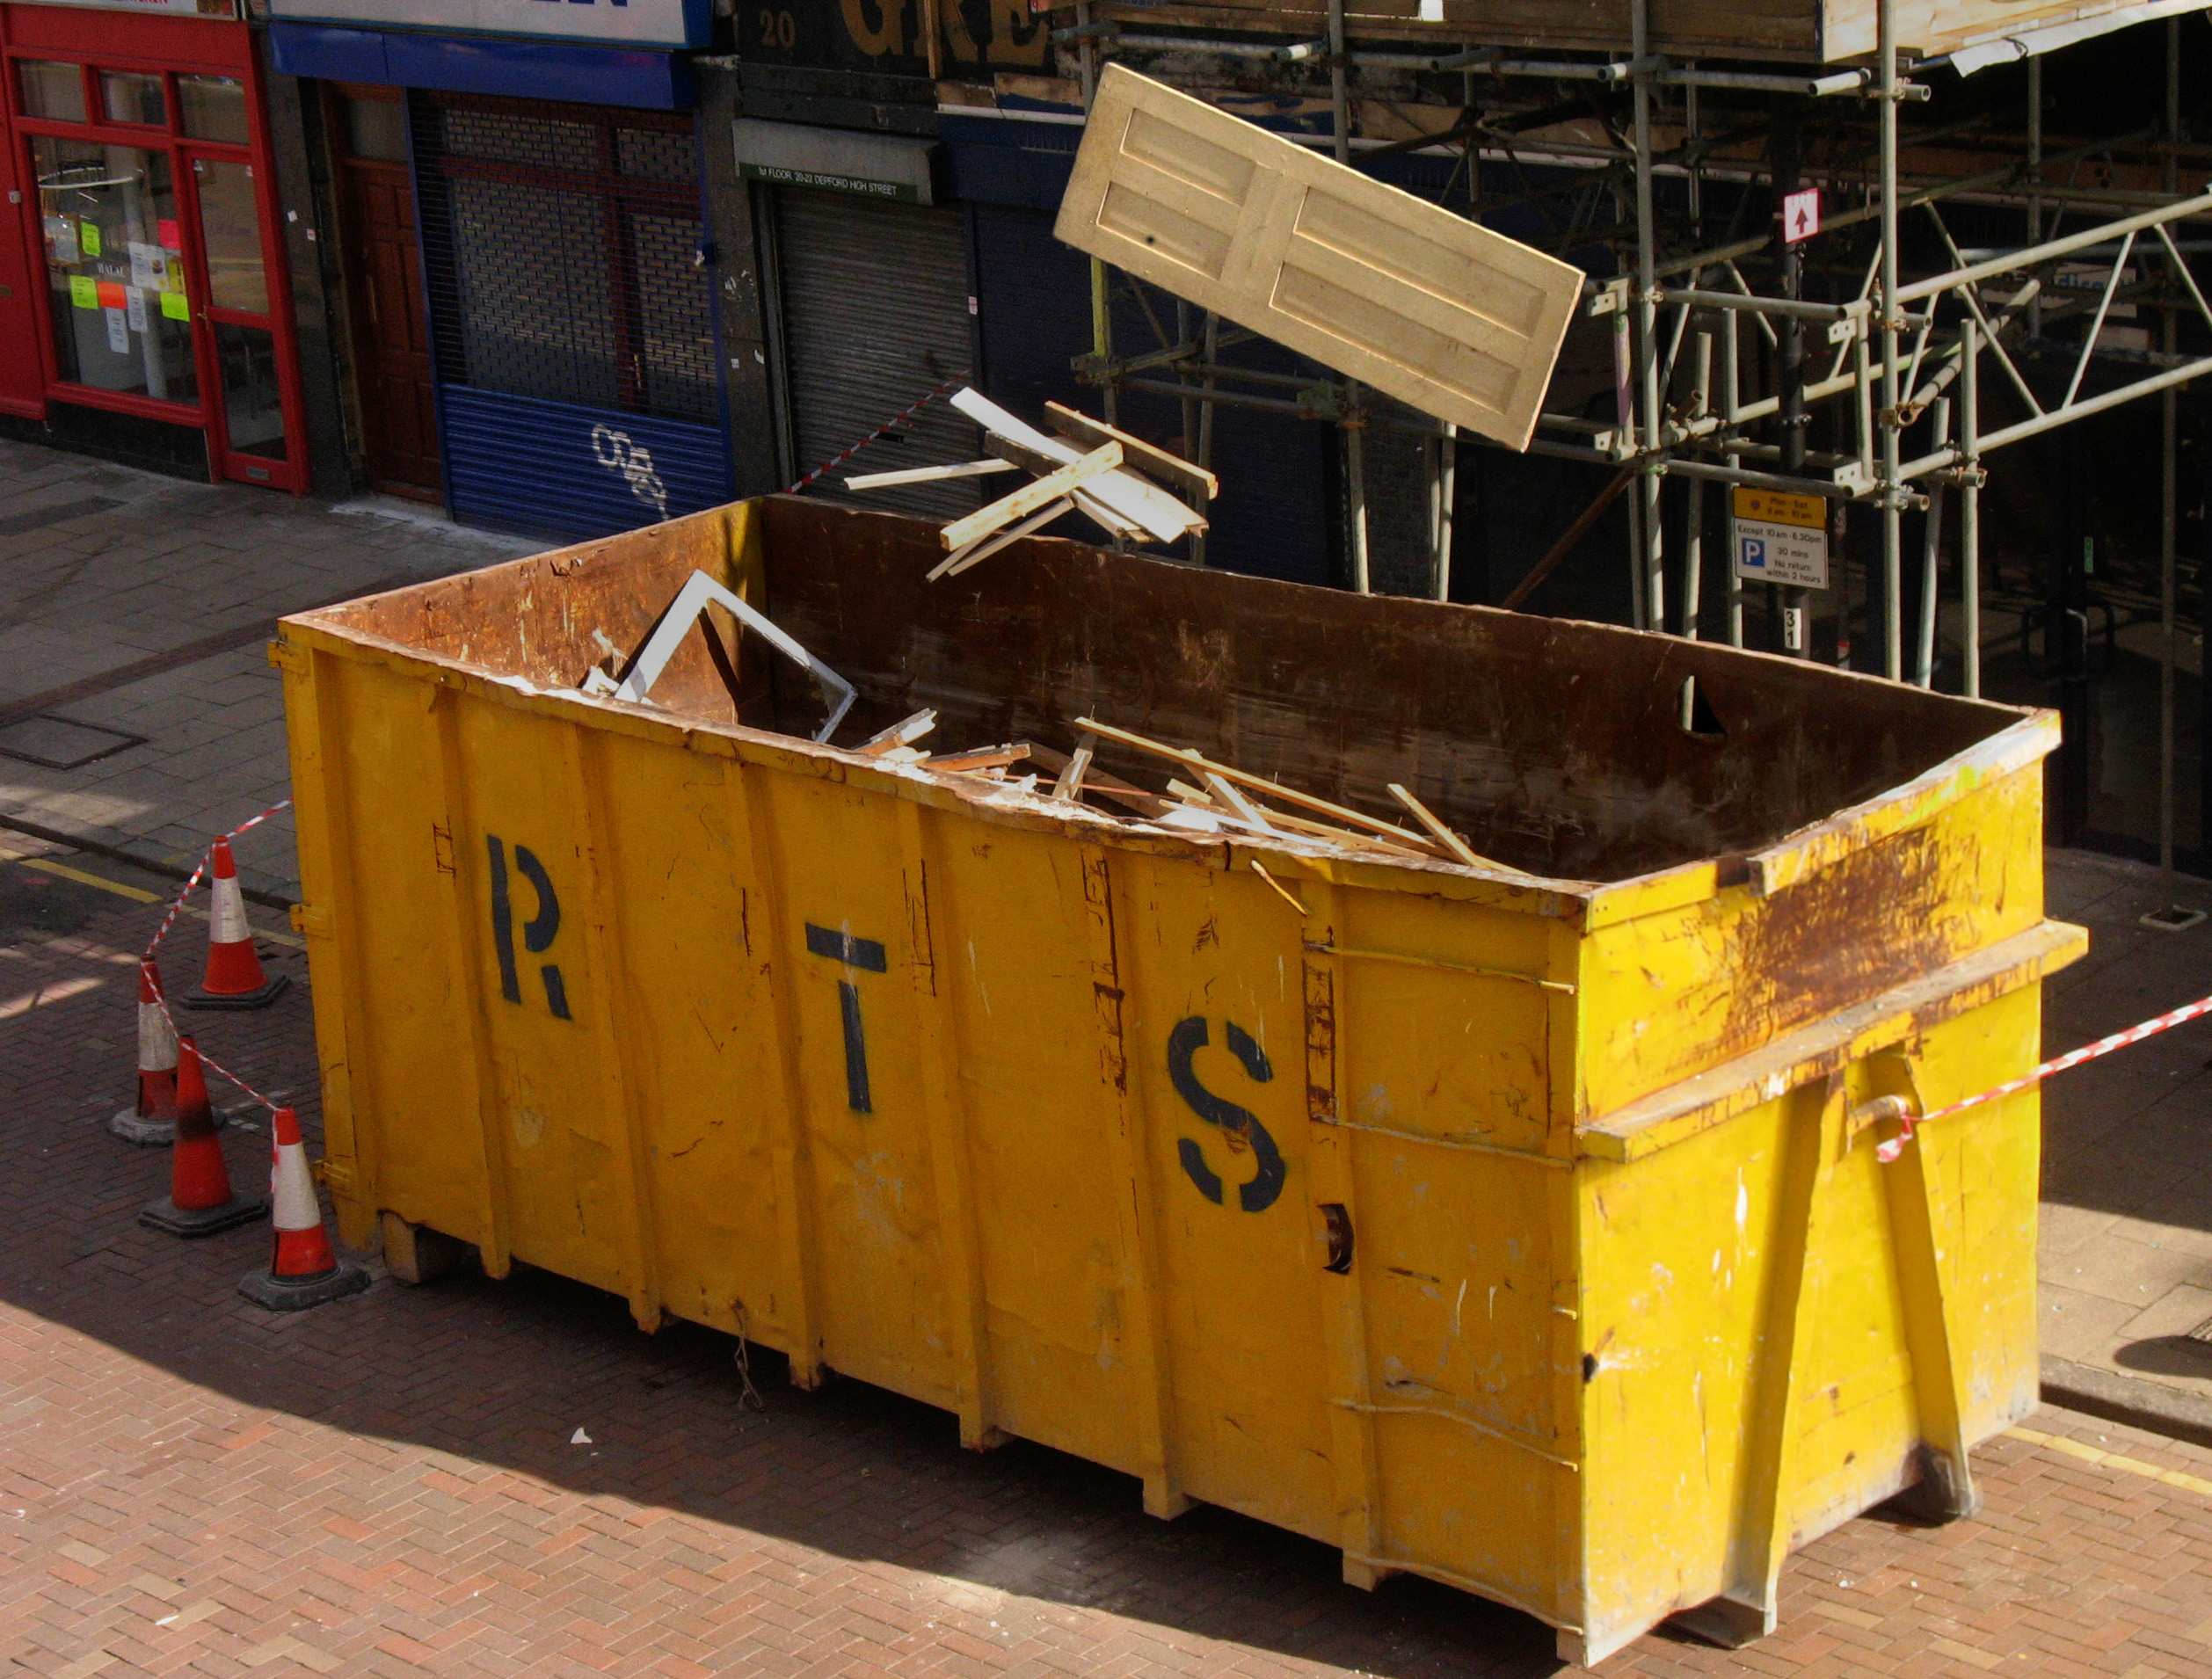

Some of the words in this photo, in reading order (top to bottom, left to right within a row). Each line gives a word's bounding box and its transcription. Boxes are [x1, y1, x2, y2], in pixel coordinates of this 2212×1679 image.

[760, 10, 794, 48] 20
[849, 180, 867, 192] HIGH
[869, 182, 897, 198] STREET
[1737, 525, 1764, 535] Except
[1745, 540, 1761, 563] P
[1791, 549, 1809, 559] mins
[1774, 559, 1786, 568] No
[1787, 561, 1811, 572] return
[1766, 568, 1790, 579] within
[1793, 571, 1799, 580] 2
[1800, 573, 1822, 585] hours
